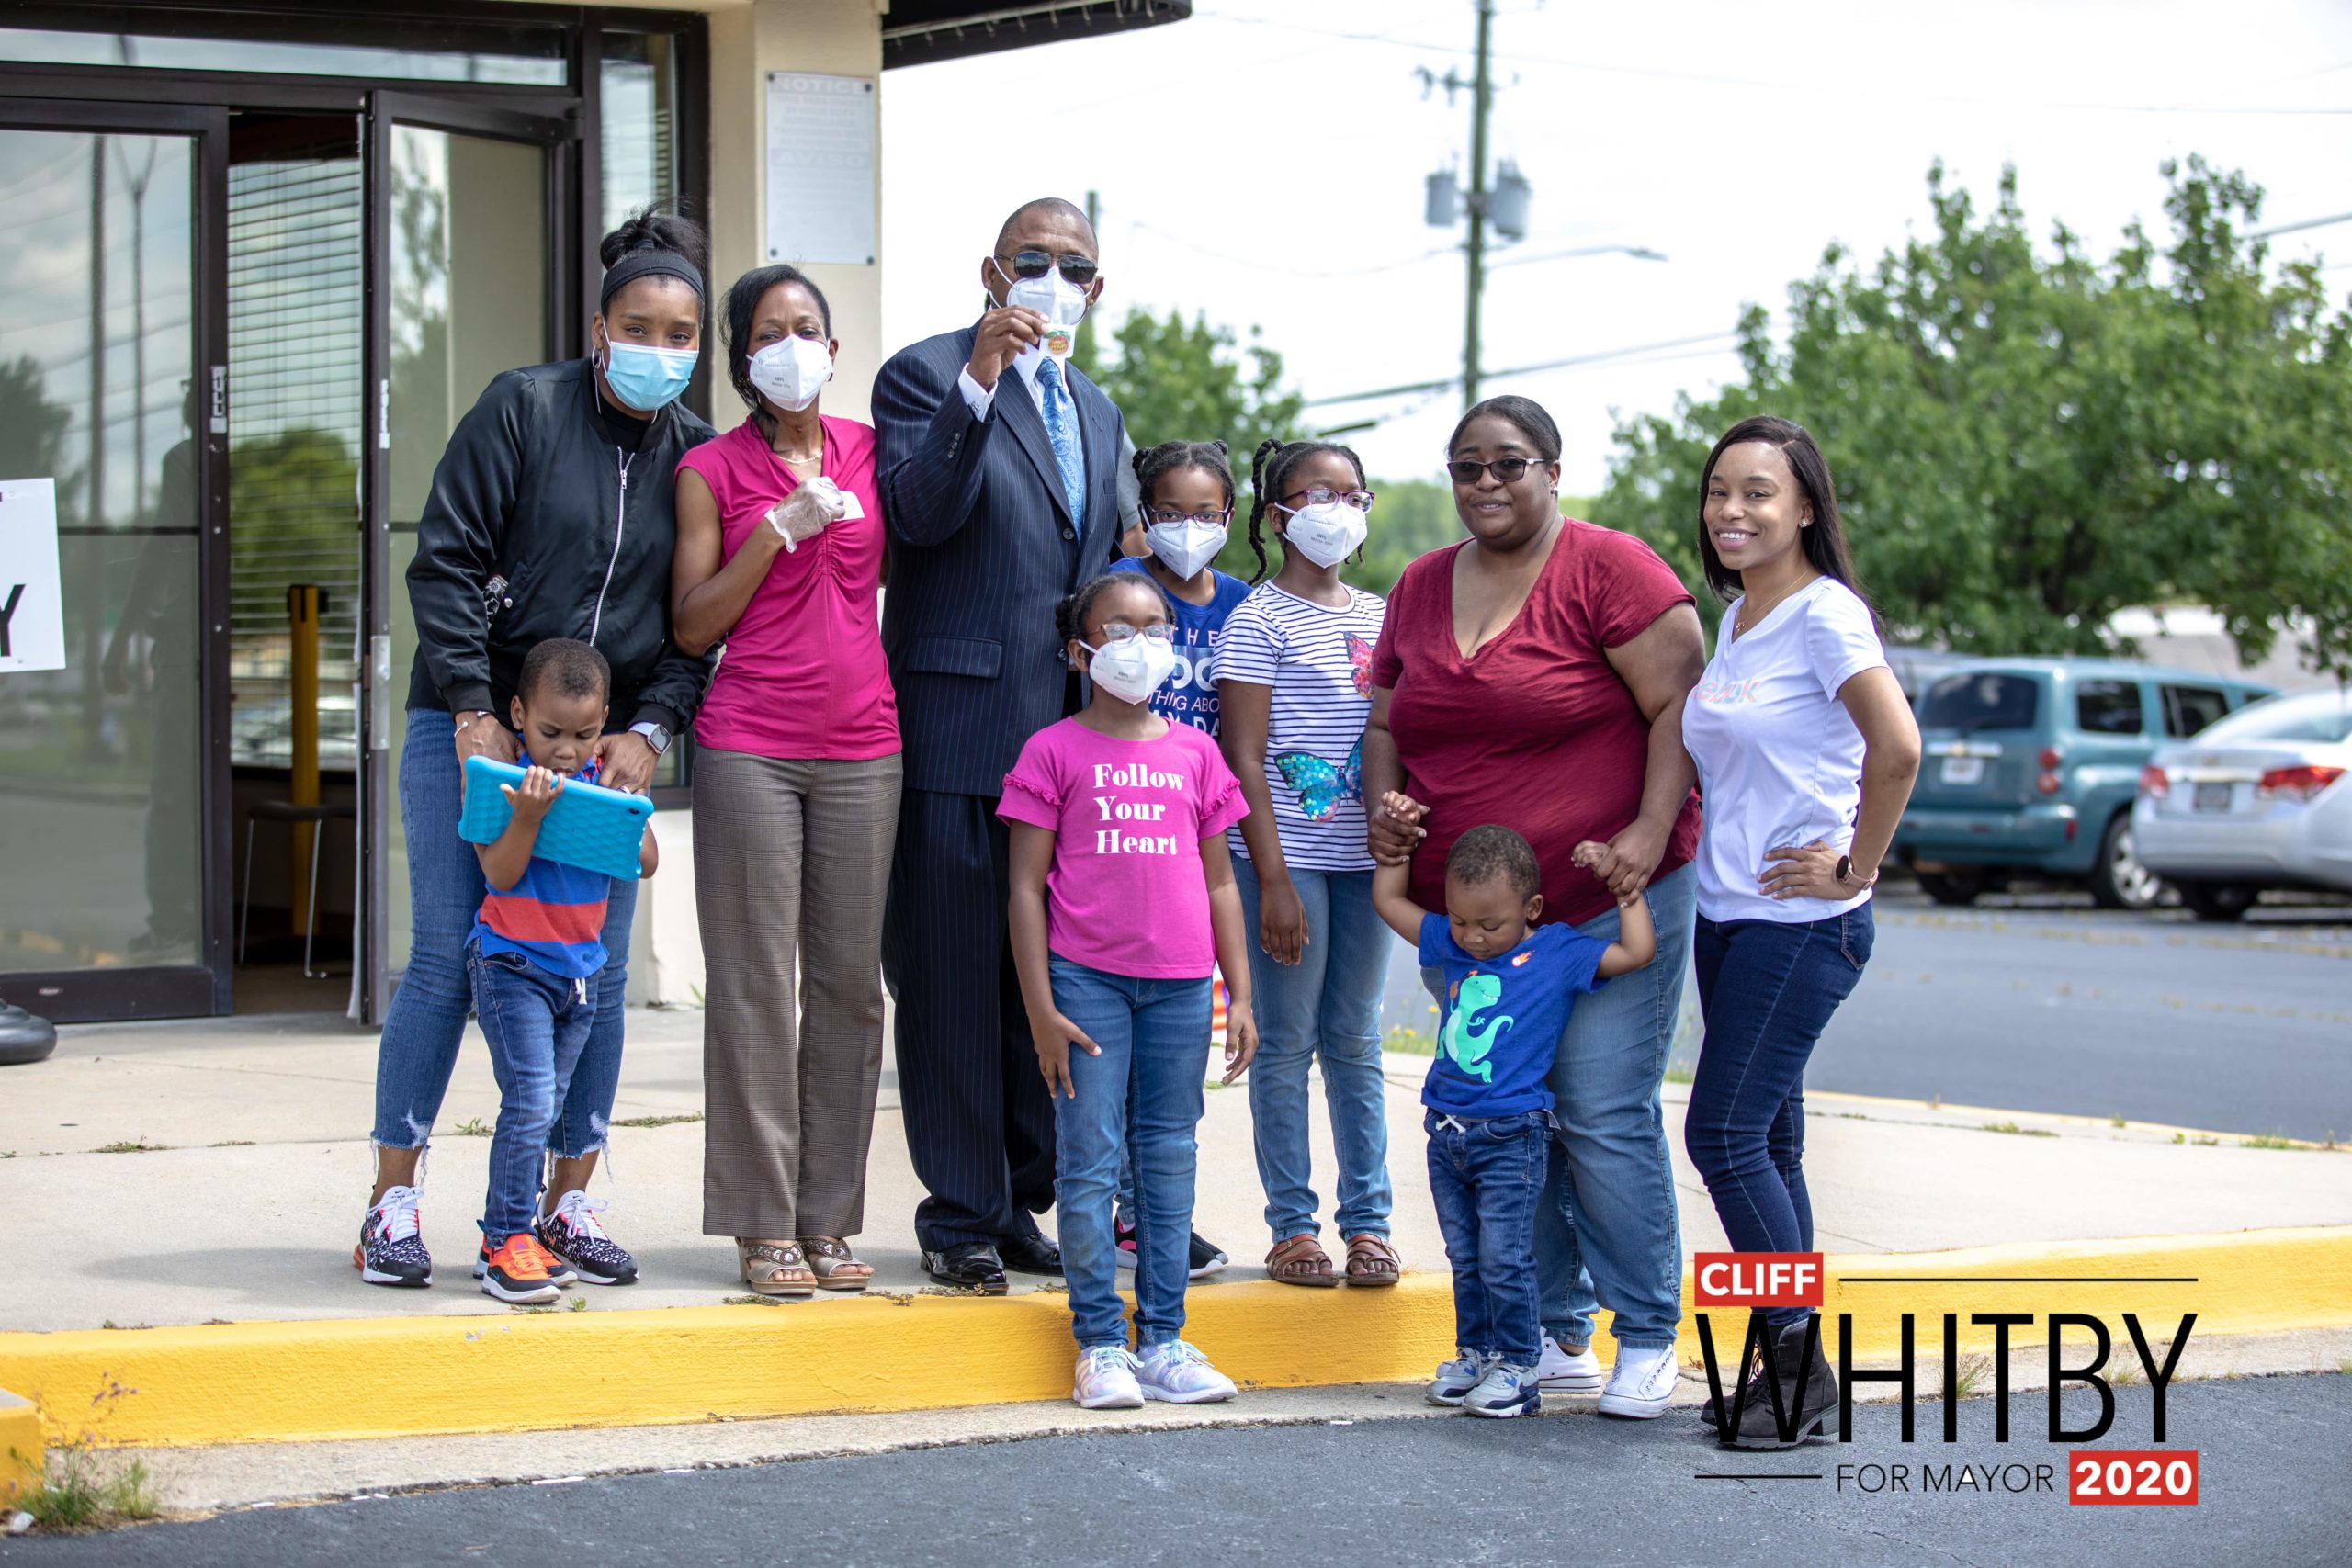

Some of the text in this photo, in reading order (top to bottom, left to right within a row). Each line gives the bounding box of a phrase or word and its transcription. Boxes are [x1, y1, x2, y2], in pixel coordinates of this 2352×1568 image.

[1092, 763, 1184, 791] Follow
[1093, 795, 1165, 821] Your
[1094, 829, 1177, 855] Heart
